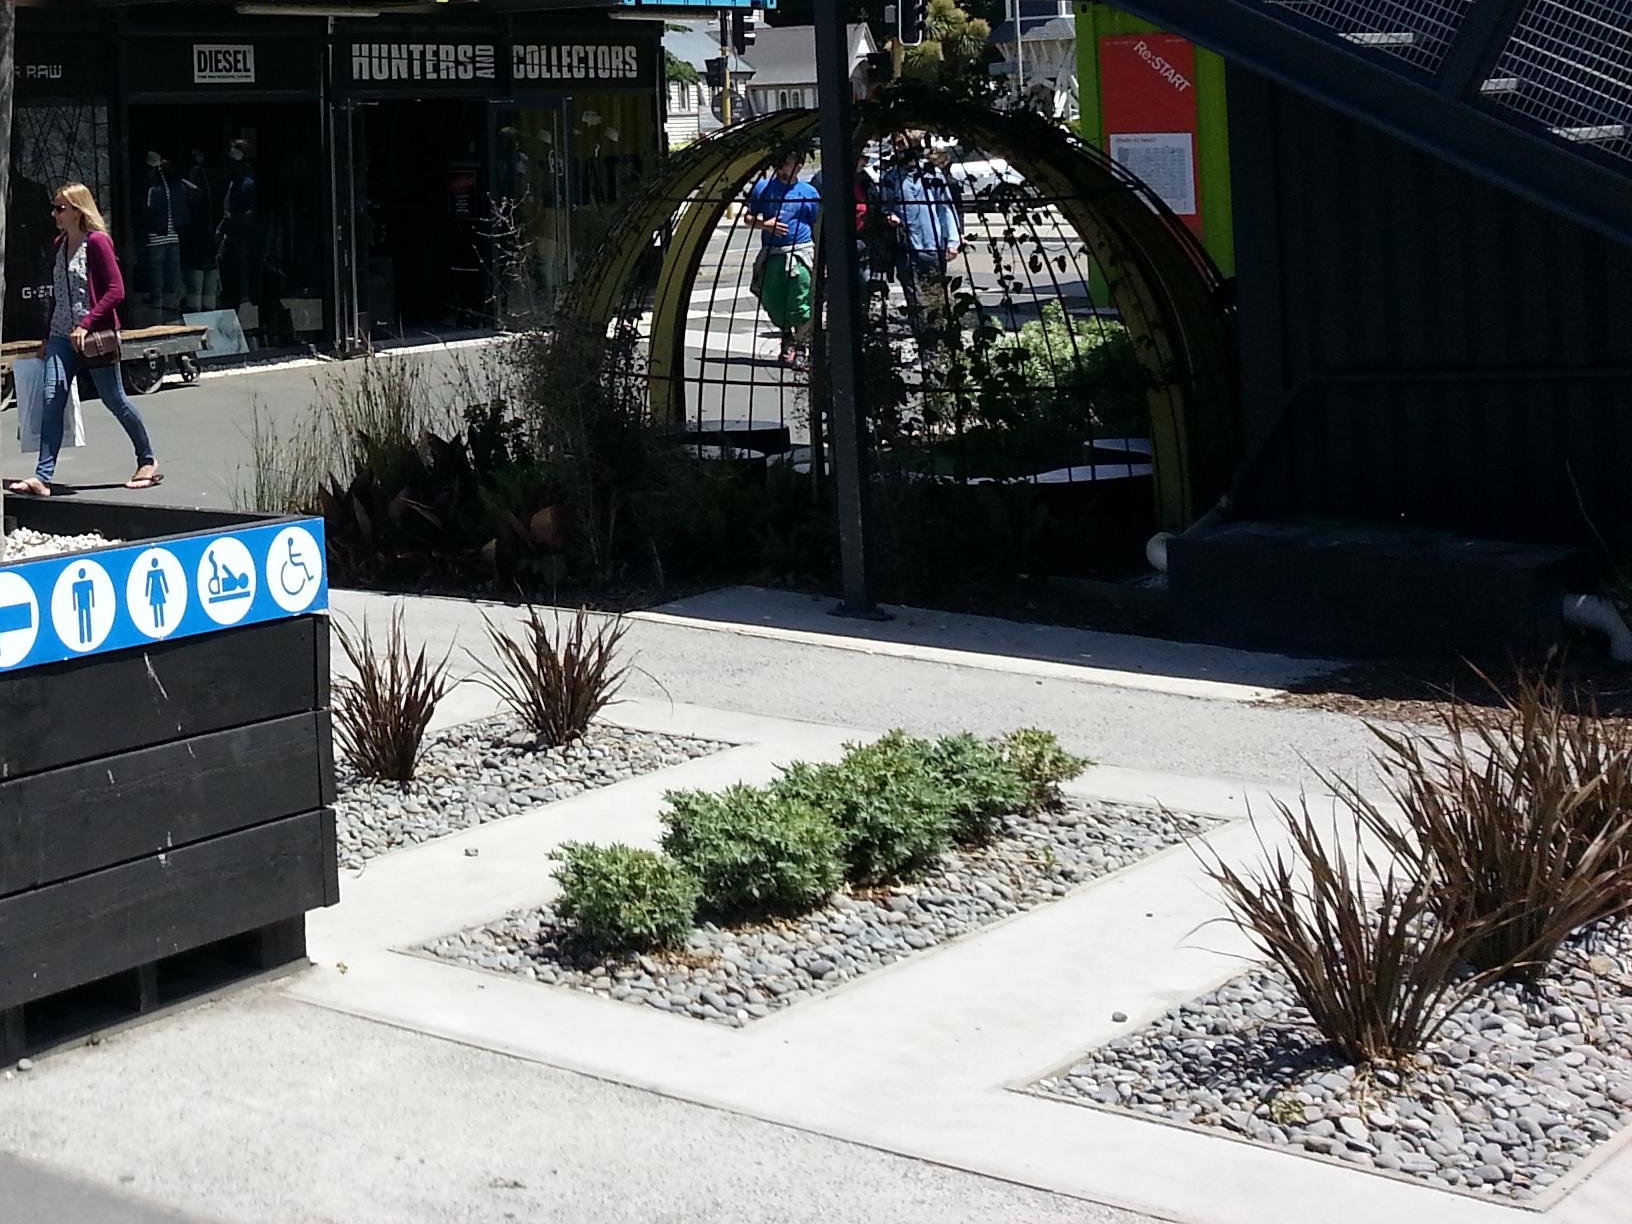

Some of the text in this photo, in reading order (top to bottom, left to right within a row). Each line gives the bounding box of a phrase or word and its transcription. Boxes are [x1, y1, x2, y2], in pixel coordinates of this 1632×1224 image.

[26, 64, 63, 80] RAW
[197, 49, 251, 73] DIESEL
[351, 43, 638, 80] HUNTERS AND COLLECTORS
[1133, 40, 1193, 93] Re:START
